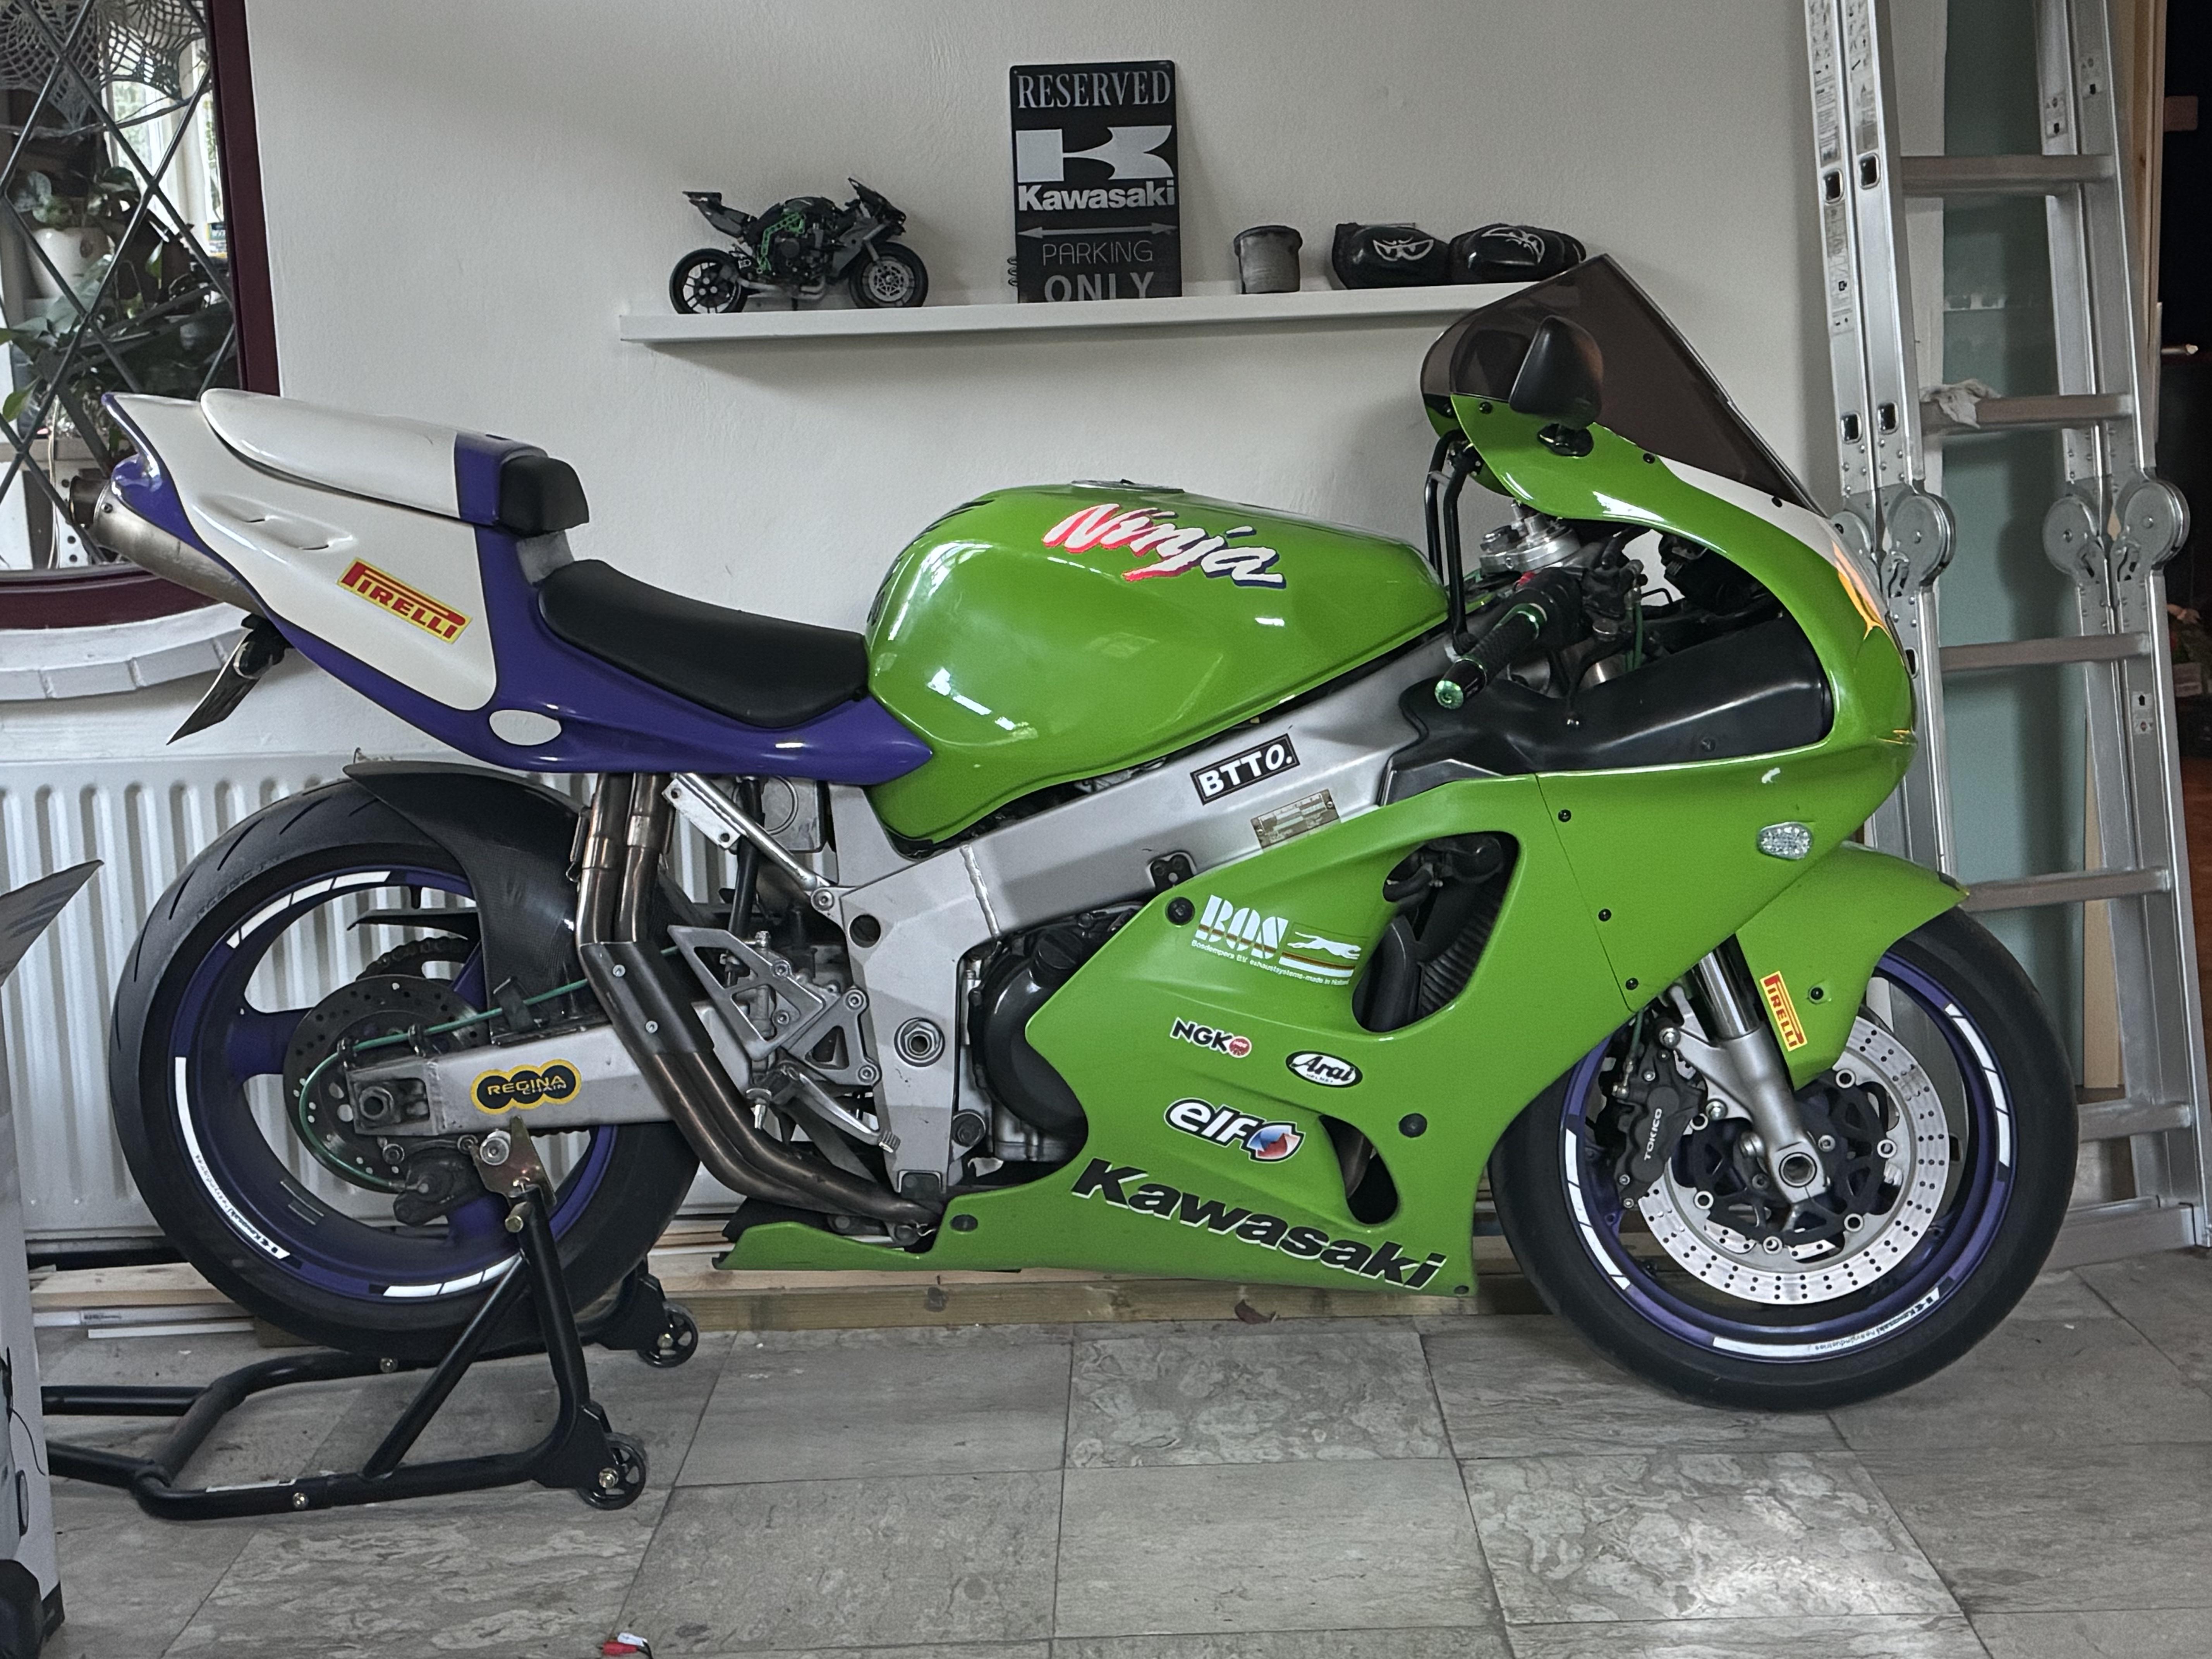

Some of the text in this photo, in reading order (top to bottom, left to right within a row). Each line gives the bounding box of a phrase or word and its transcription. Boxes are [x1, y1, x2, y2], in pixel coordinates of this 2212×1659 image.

[1018, 70, 1171, 109] RESERVED
[1018, 180, 1175, 211] Kawasaki
[1042, 240, 1153, 266] PARKING
[1044, 272, 1154, 302] ONLY
[1042, 503, 1286, 589] Ninja
[341, 561, 466, 639] PIRELLI
[1764, 974, 1805, 1048] PIRELLI
[1171, 1019, 1232, 1052] NGK
[487, 1075, 566, 1095] REGINA
[1290, 1056, 1355, 1082] Arai
[1170, 1102, 1259, 1143] elf
[1644, 1108, 1662, 1161] TOKICO
[1071, 1158, 1447, 1290] Kawasaki
